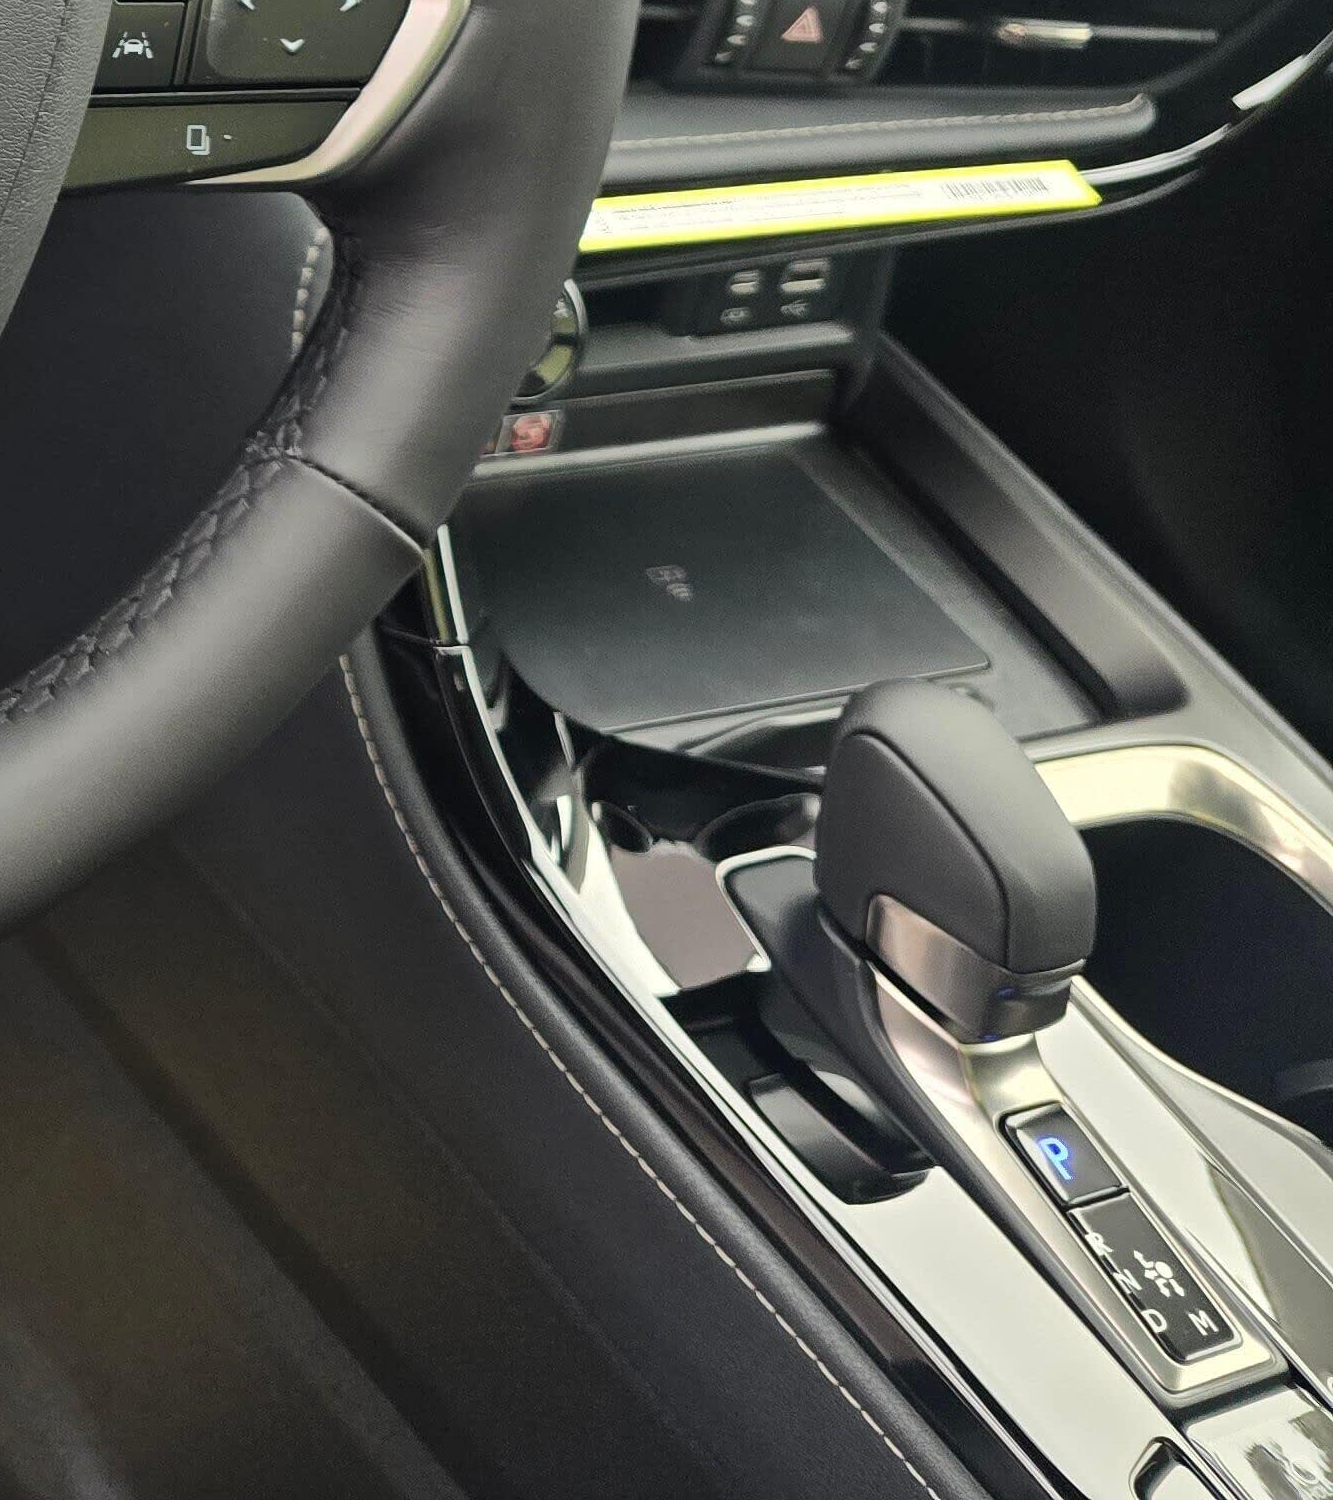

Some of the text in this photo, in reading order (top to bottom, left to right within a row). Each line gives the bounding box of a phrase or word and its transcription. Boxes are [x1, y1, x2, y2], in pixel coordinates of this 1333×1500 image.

[1038, 1135, 1072, 1182] P
[1085, 1230, 1114, 1257] R
[1113, 1269, 1142, 1296] N
[1141, 1308, 1168, 1334] D
[1189, 1310, 1219, 1337] M
